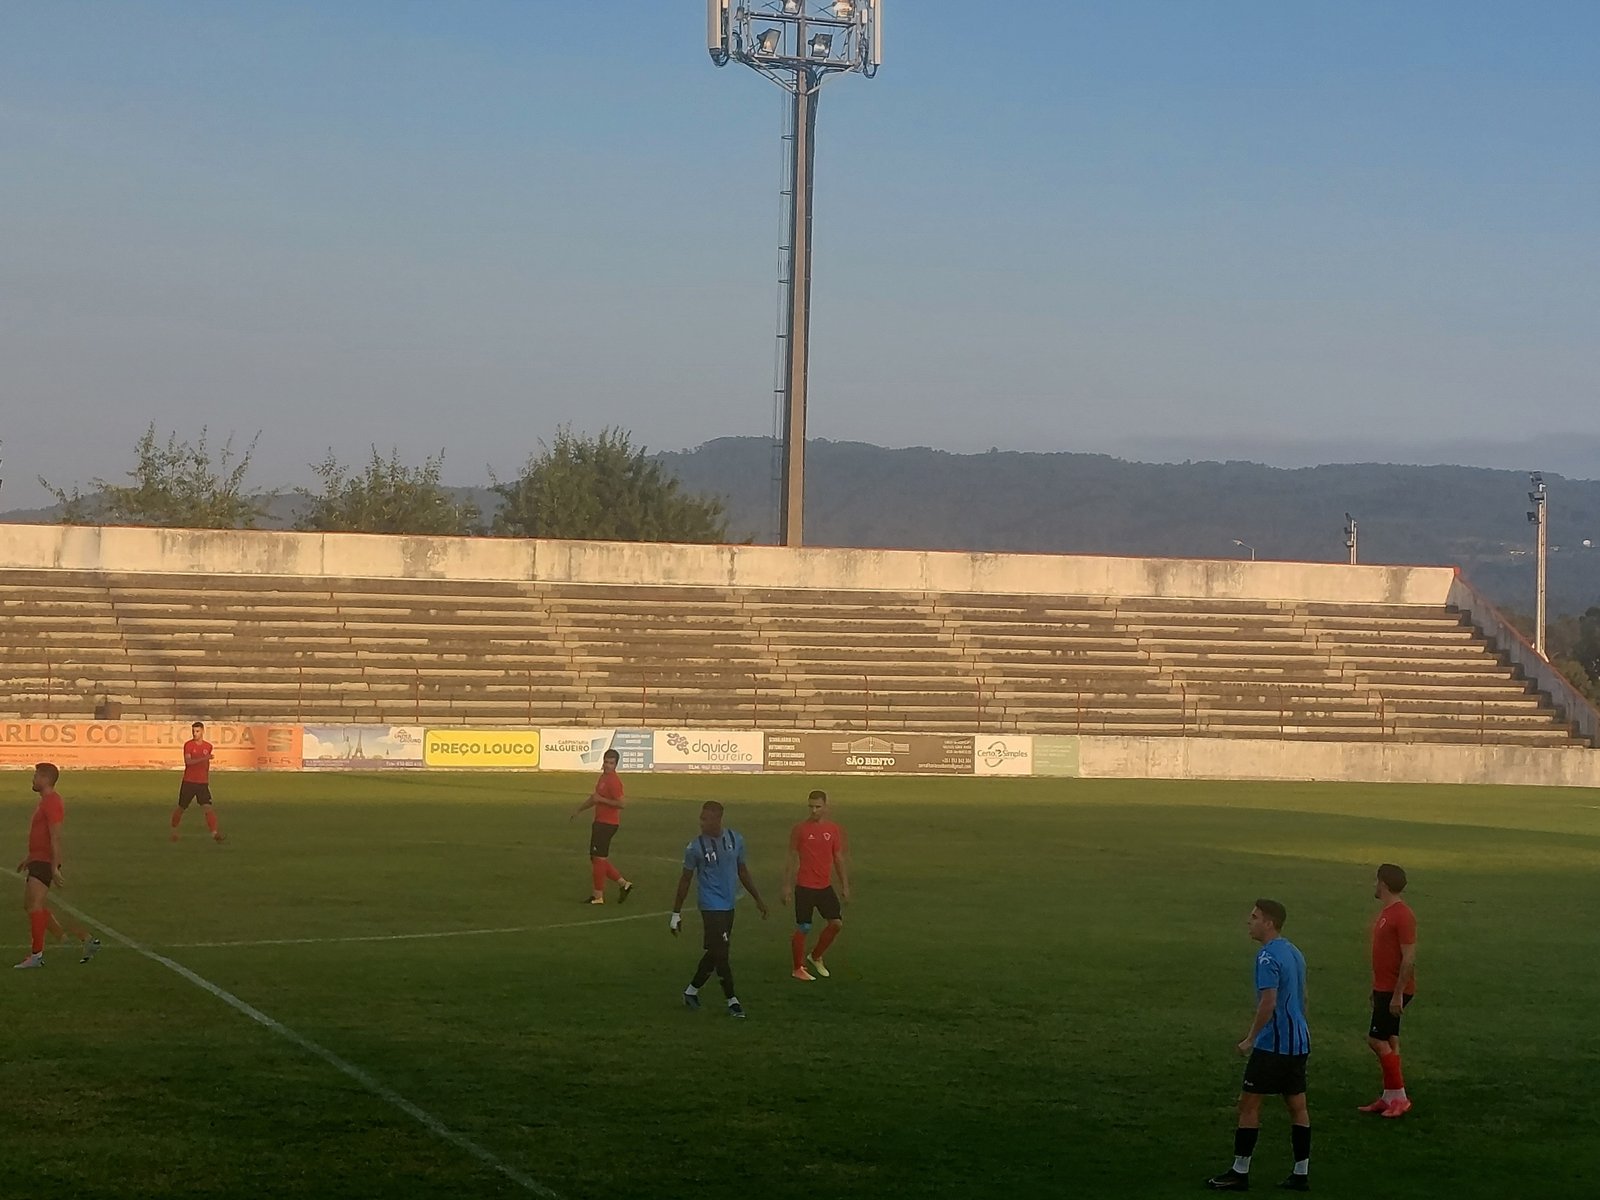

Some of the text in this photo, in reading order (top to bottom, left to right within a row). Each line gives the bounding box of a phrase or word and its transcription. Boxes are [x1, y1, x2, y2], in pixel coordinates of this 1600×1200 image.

[430, 742, 535, 756] PREÇO LOUCO
[545, 744, 590, 753] SALGUEIRO
[845, 755, 896, 766] SÃO BENTO
[705, 851, 718, 863] 11
